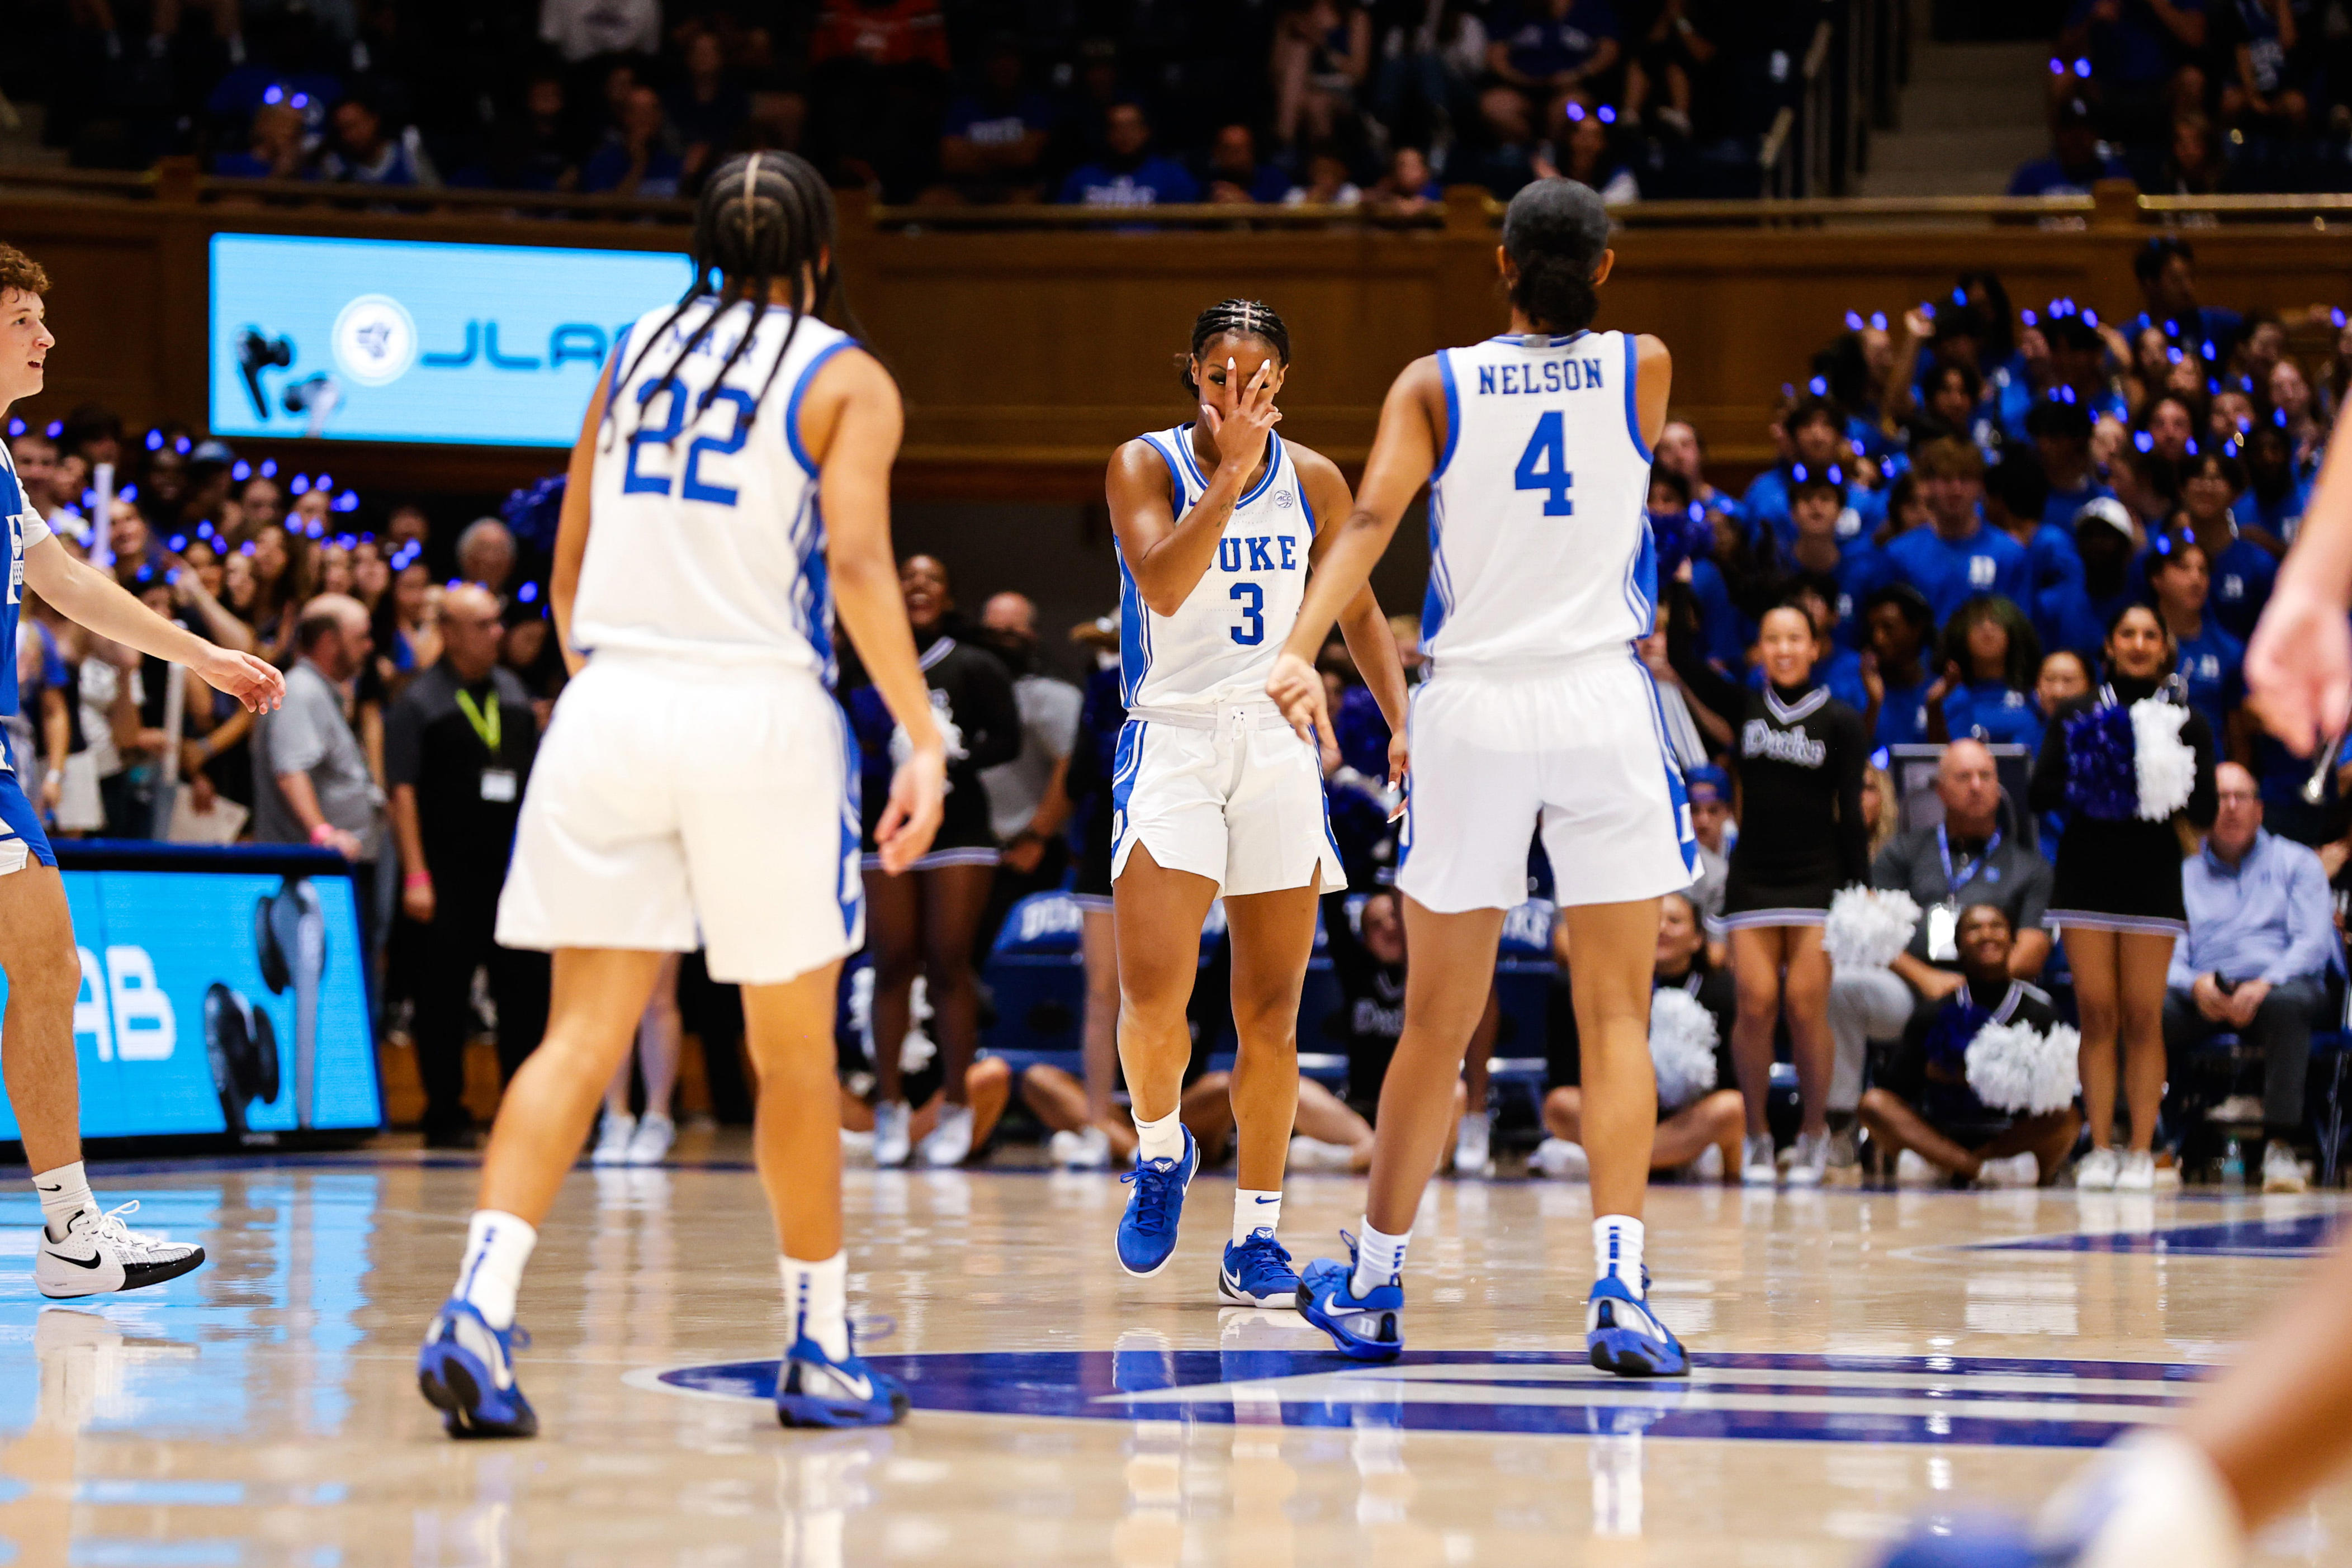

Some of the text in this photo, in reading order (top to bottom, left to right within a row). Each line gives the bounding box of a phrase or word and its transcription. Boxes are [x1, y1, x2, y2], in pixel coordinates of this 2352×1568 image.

[423, 320, 636, 371] JLA
[1479, 358, 1603, 395] NELSON
[623, 377, 756, 507] 22
[1515, 410, 1574, 517] 4
[1208, 535, 1296, 572] UKE
[1229, 582, 1264, 646] 3
